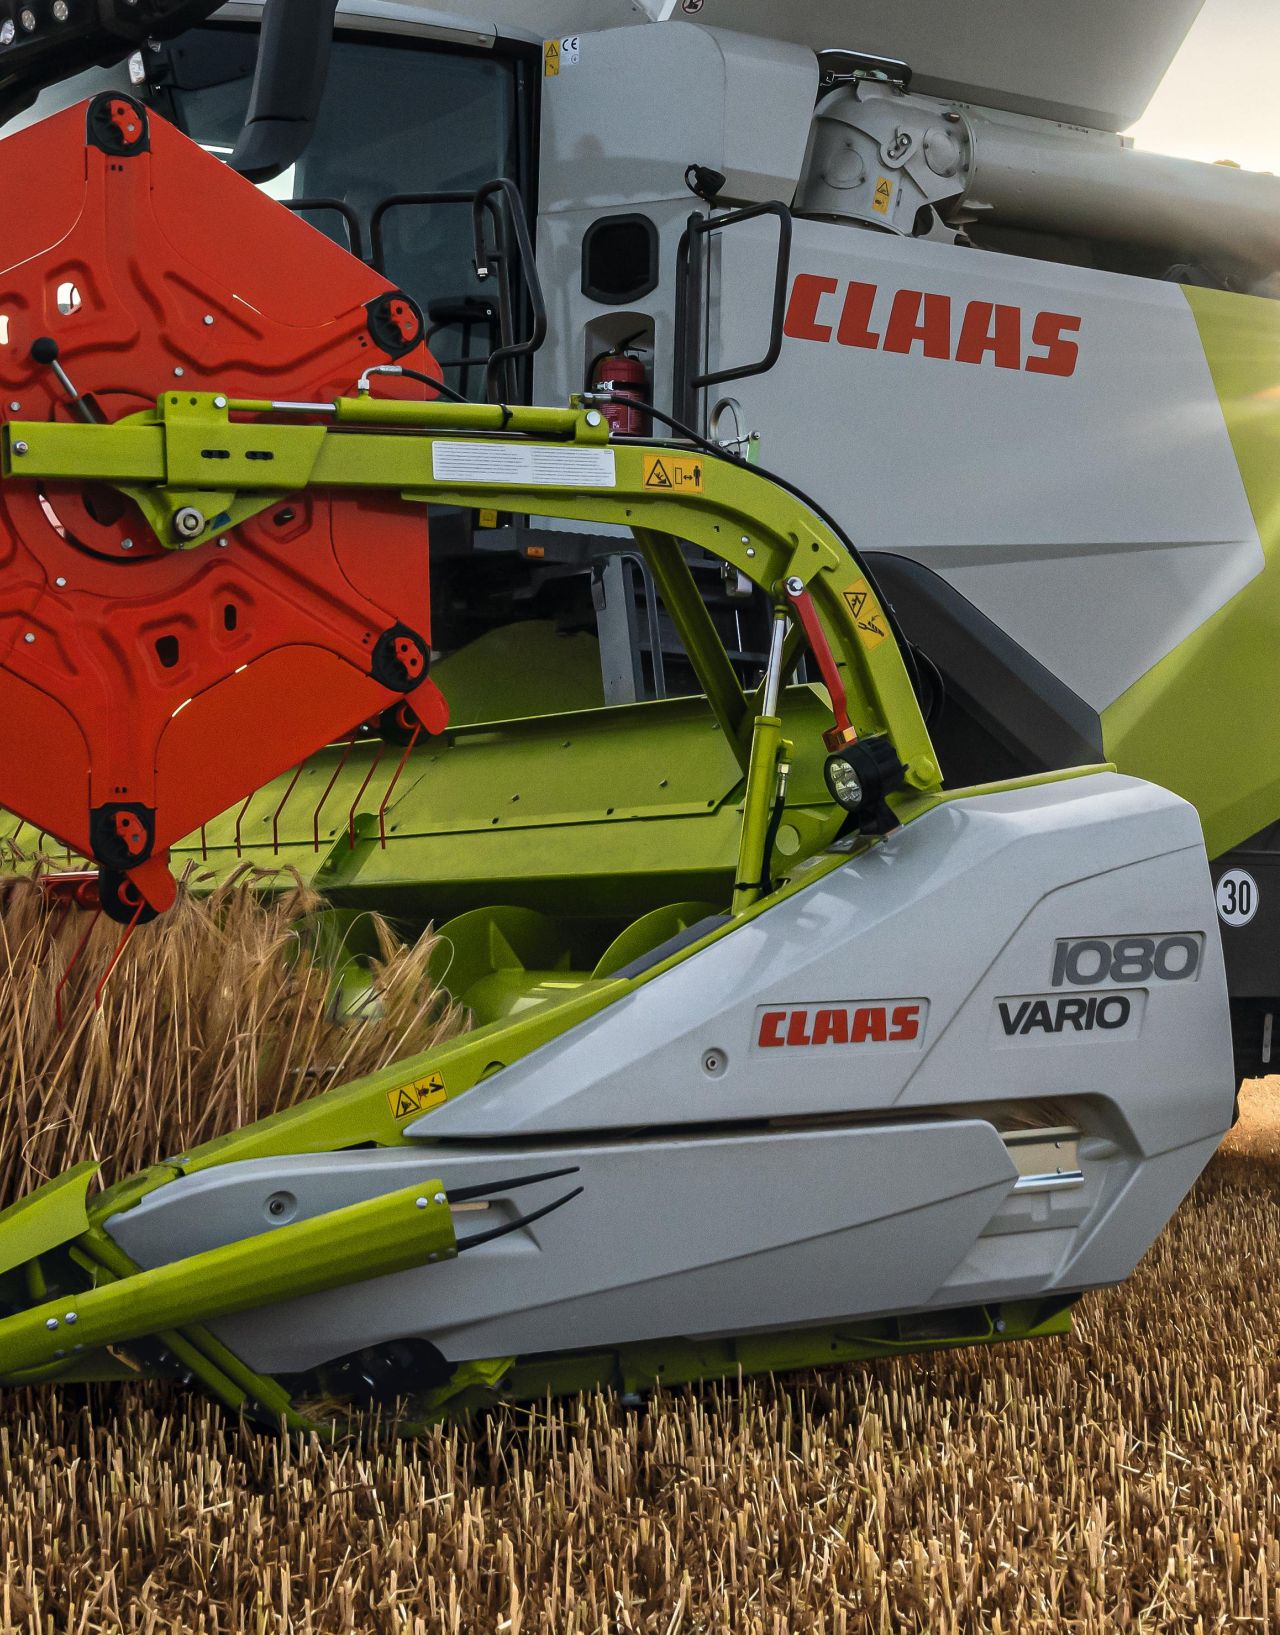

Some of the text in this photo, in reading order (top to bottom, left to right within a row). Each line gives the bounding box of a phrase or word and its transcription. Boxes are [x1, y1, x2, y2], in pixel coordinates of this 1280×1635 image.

[783, 273, 1082, 377] CLAAS
[1222, 879, 1251, 915] 30
[1051, 936, 1200, 987] 1080
[758, 1006, 920, 1047] CLAAS
[998, 995, 1131, 1036] VARIO
